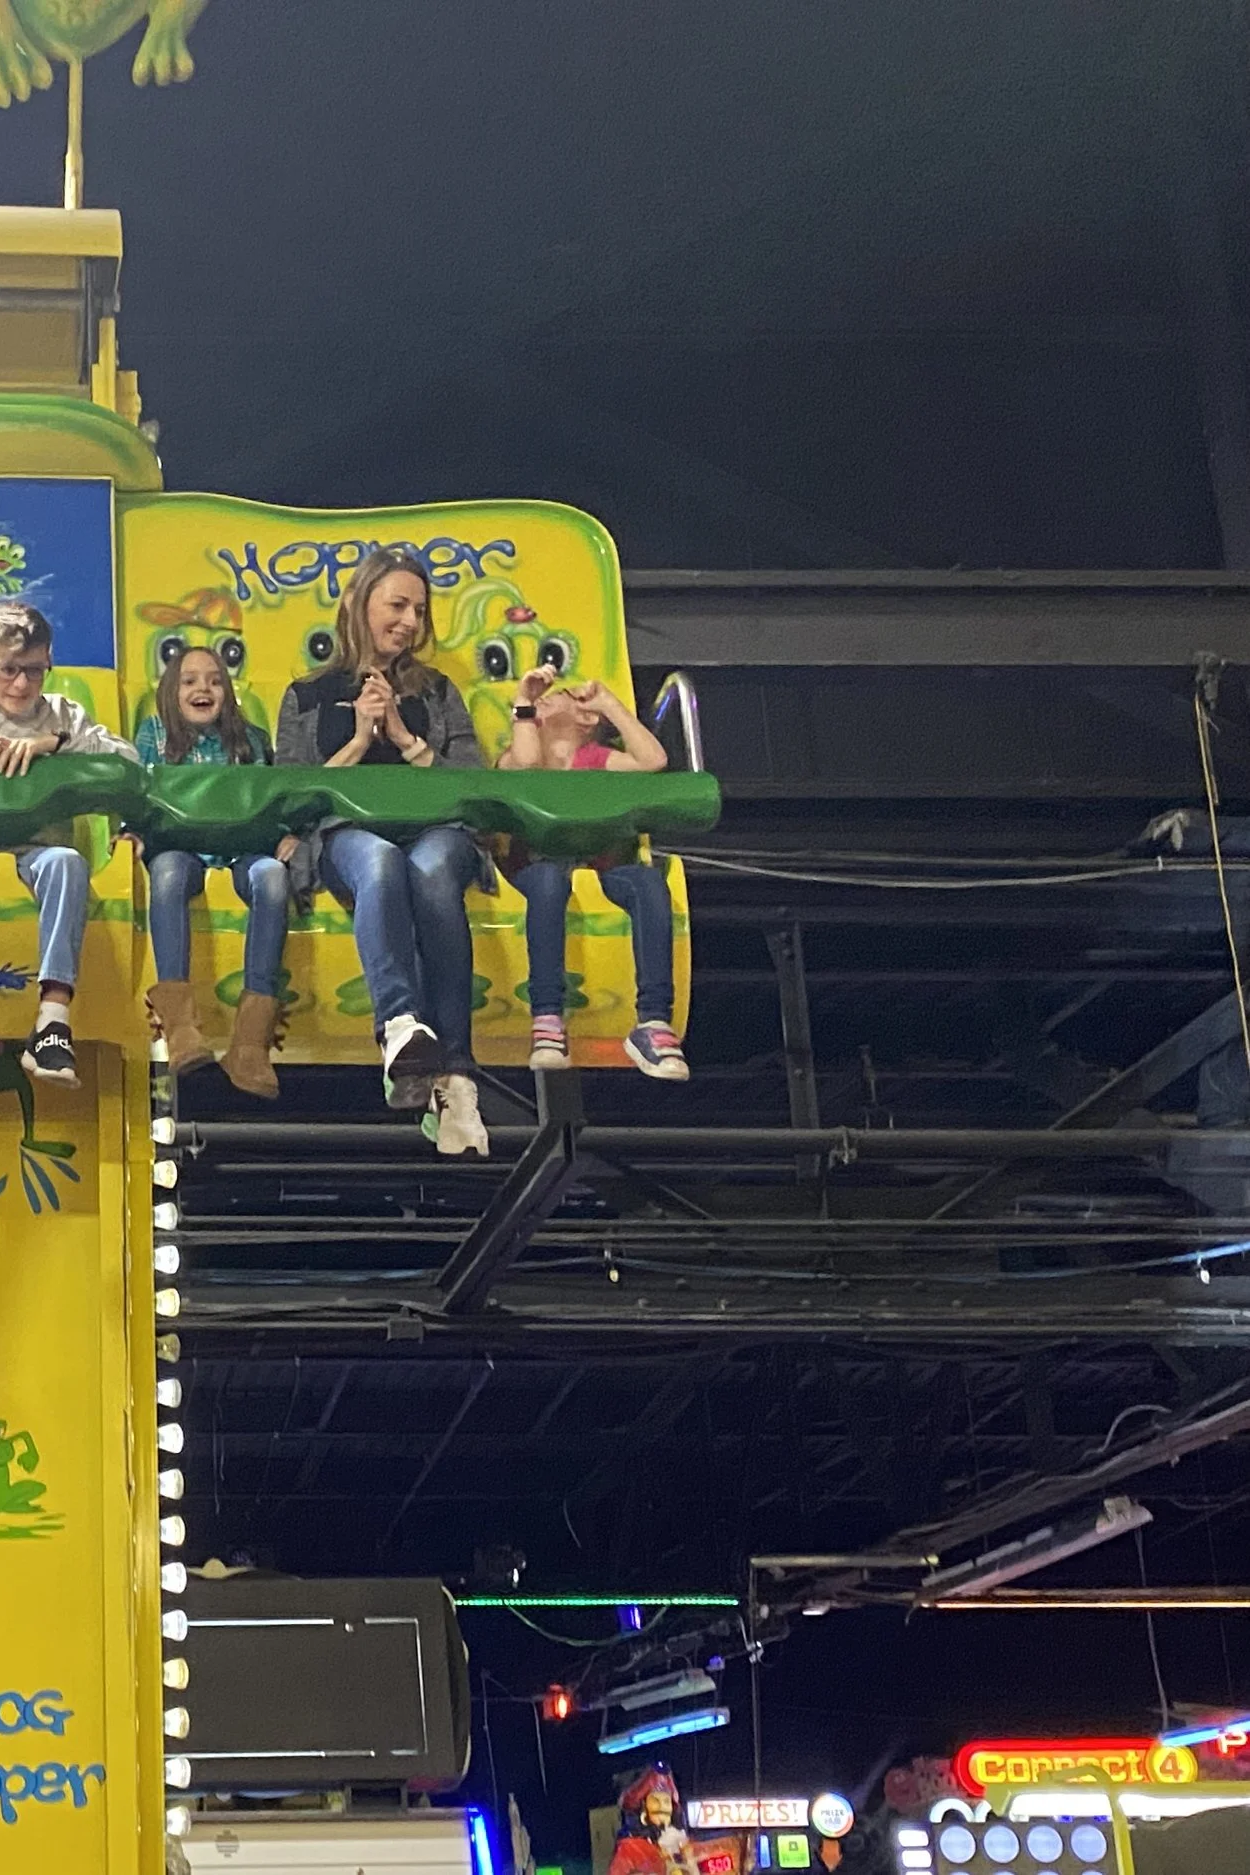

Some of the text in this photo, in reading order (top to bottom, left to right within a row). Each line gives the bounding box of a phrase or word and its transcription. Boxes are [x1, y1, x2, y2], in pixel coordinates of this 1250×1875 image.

[35, 1034, 72, 1054] adid
[1159, 1751, 1183, 1779] 4
[702, 1803, 799, 1824] PRIZES!
